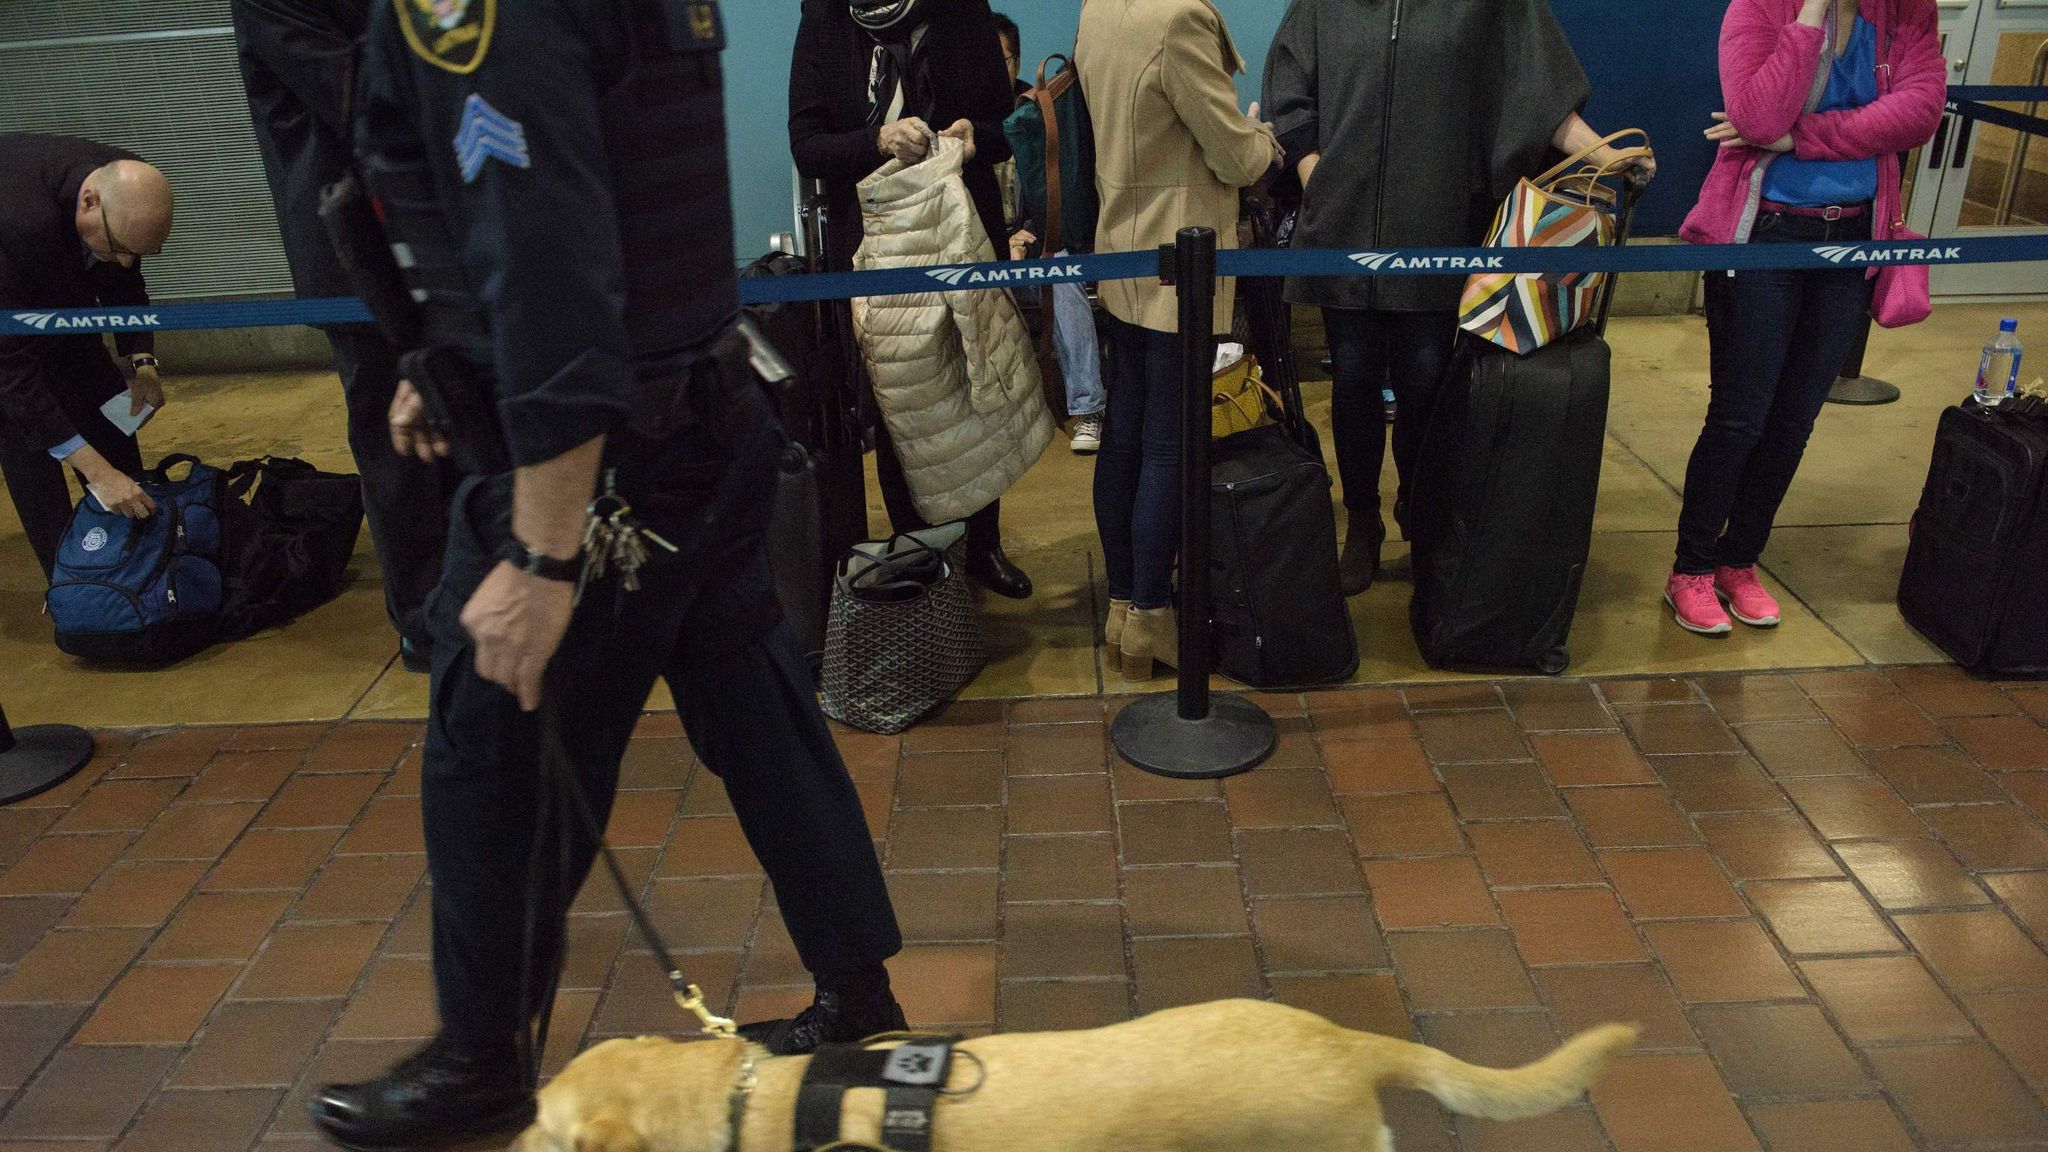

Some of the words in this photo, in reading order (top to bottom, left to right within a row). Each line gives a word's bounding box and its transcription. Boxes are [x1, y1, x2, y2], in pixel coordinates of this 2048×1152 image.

[1850, 247, 1961, 262] AMTRAK
[1389, 256, 1504, 269] AMTRAK
[968, 264, 1082, 283] AMTRAK
[55, 314, 160, 328] AMTRAK
